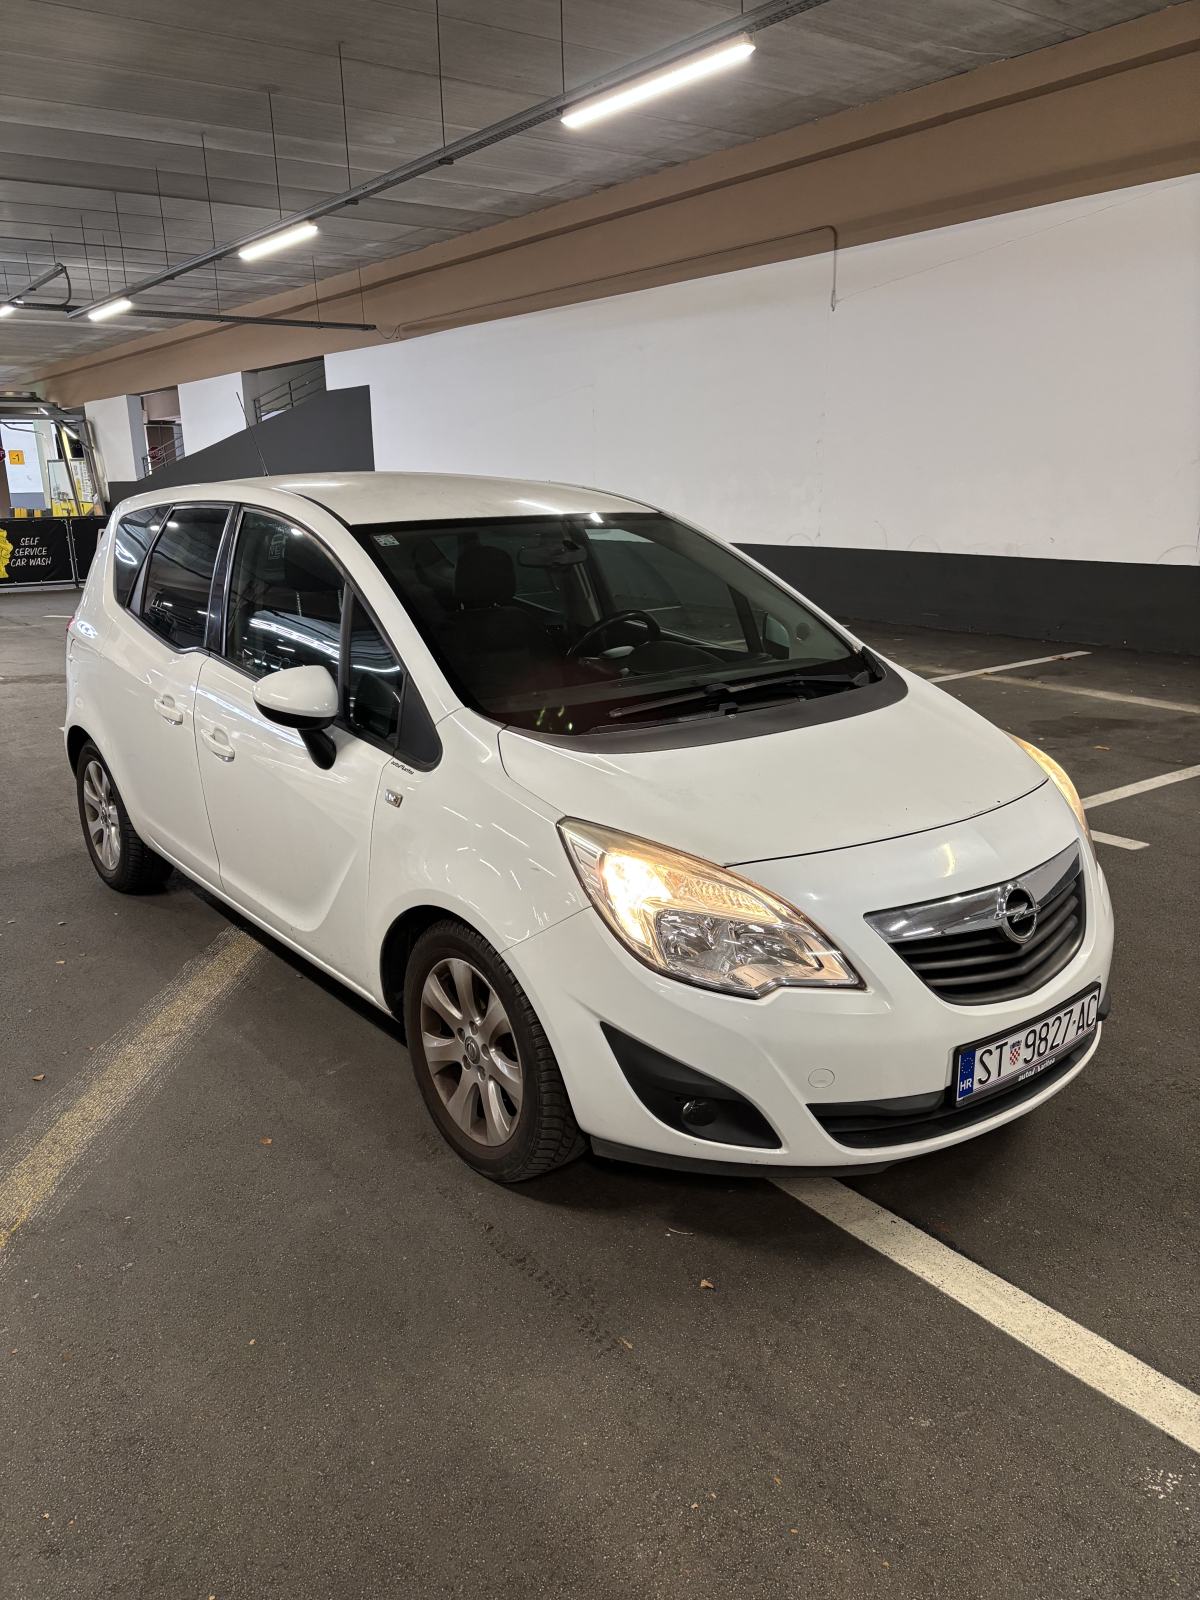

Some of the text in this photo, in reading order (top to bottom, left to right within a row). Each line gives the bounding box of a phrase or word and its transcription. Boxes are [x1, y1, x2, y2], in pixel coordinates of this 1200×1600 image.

[12, 453, 20, 463] -1
[20, 536, 40, 546] SELF
[14, 546, 48, 557] SERVICE
[11, 556, 52, 567] CAR WASH
[977, 1041, 1009, 1085] ST
[959, 1077, 973, 1092] HR
